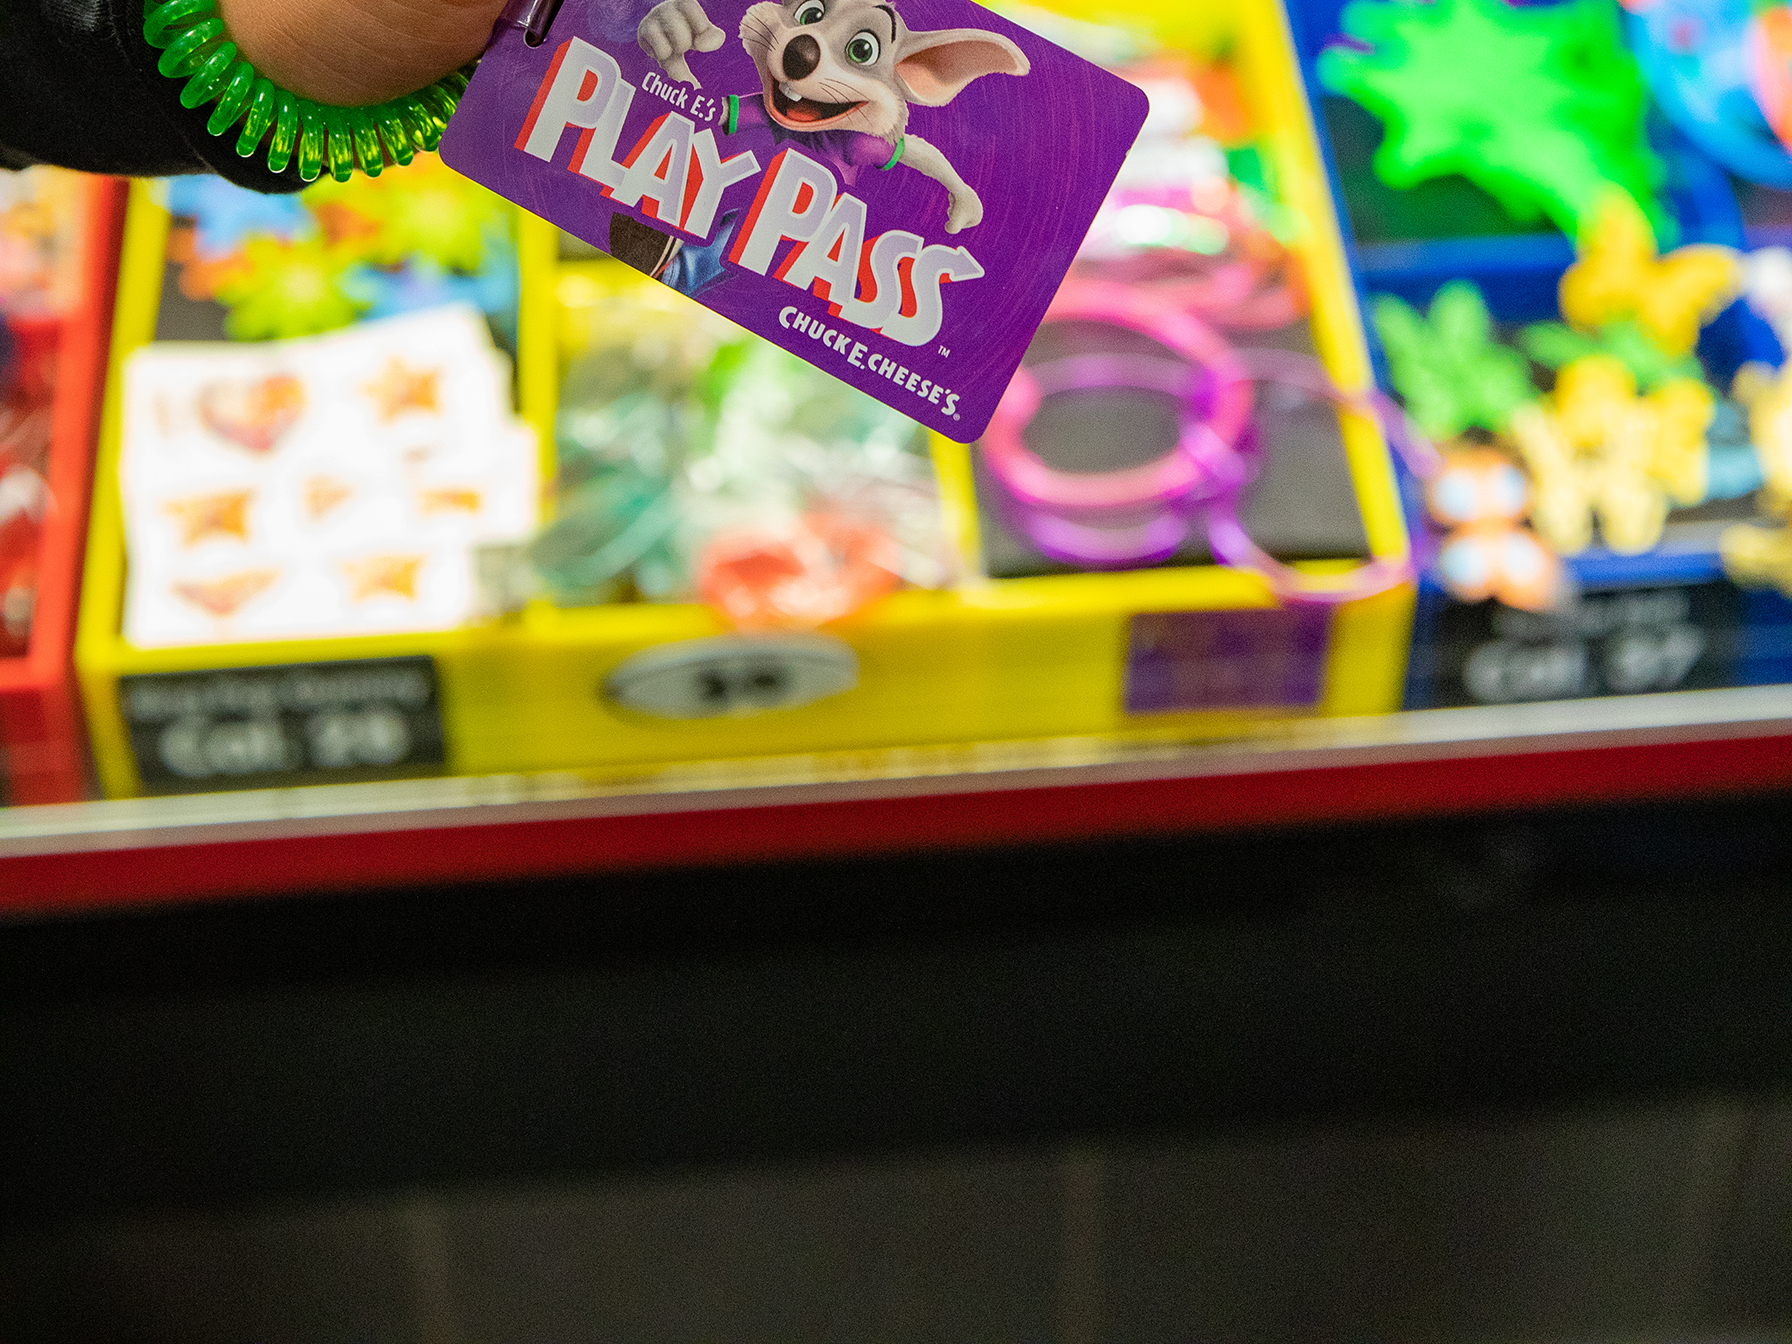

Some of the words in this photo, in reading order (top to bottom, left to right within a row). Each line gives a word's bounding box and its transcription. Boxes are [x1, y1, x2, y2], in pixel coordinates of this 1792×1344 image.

[641, 71, 689, 109] Chuck
[514, 36, 761, 240] PLAY
[728, 147, 986, 347] PASS
